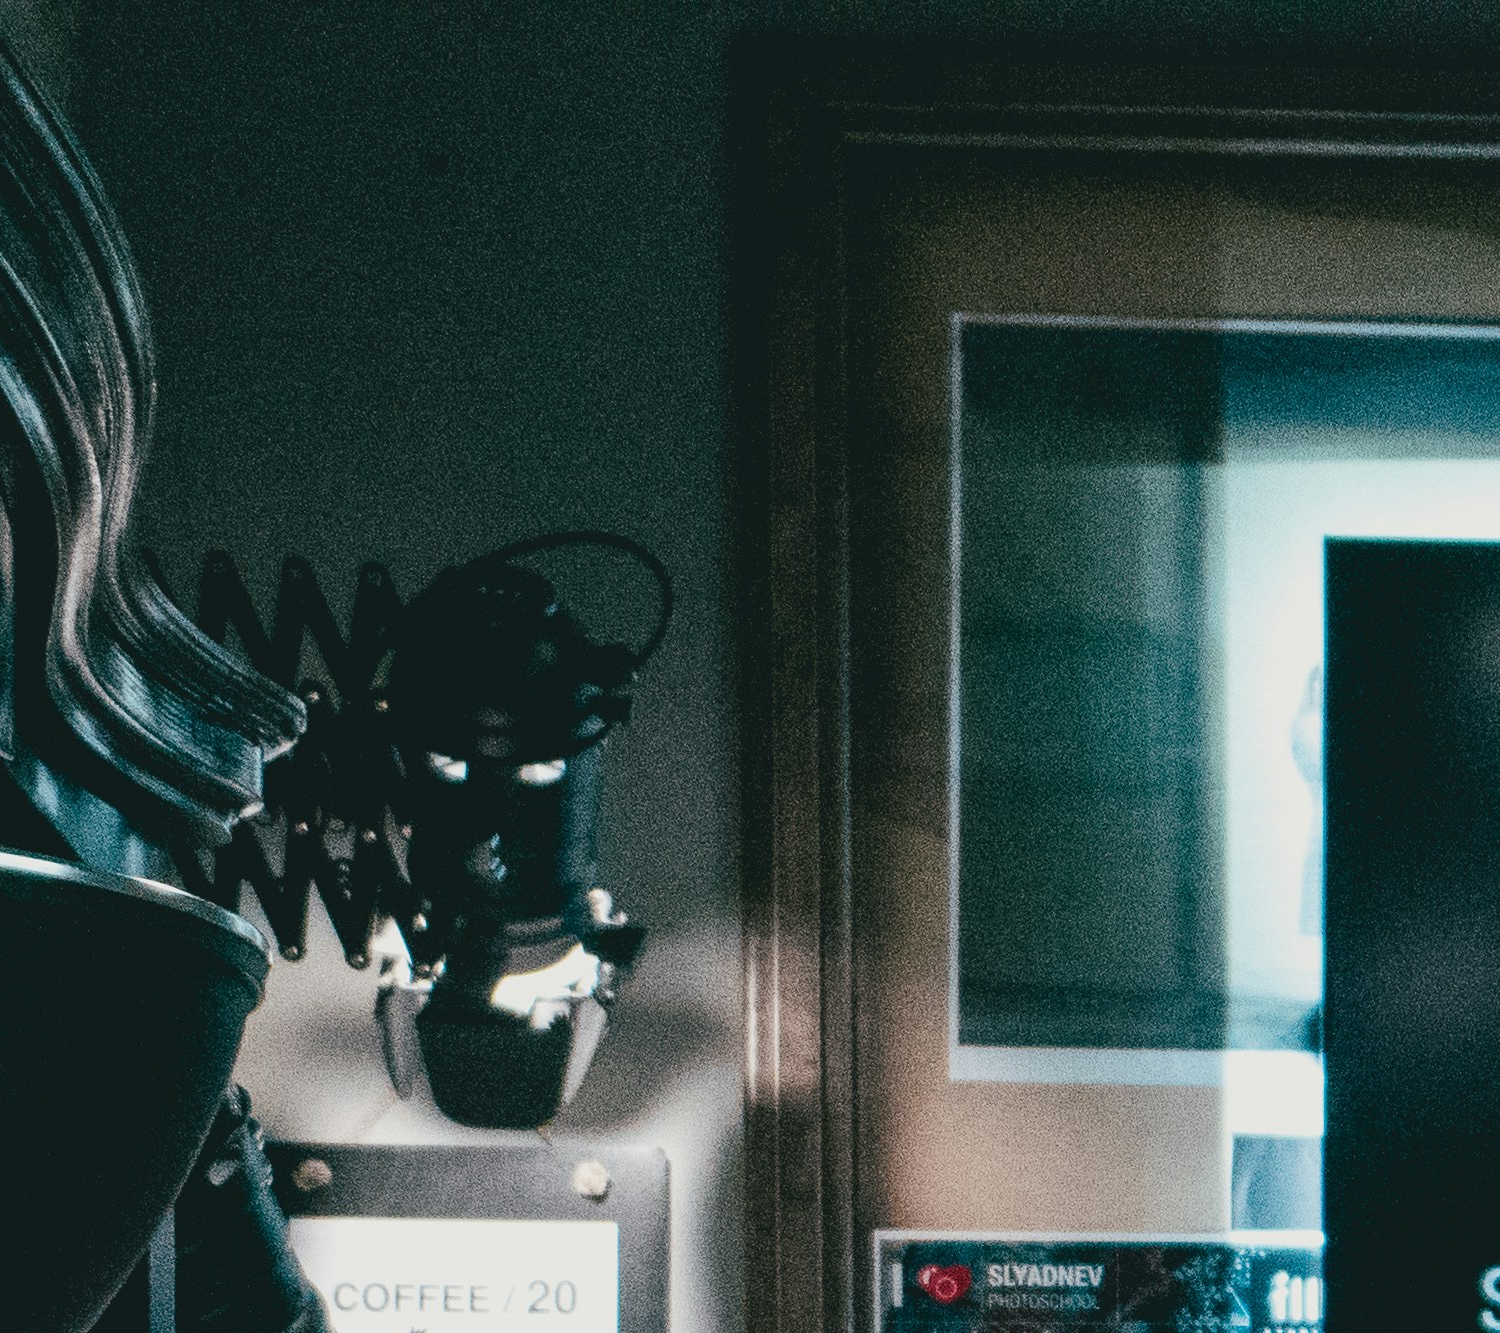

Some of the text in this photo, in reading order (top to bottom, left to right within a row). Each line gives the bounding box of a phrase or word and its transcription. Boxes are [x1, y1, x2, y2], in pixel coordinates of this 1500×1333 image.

[987, 1263, 1105, 1288] SLYADNEV
[333, 1281, 490, 1314] COFFEE
[527, 1280, 578, 1315] 20
[988, 1293, 1101, 1310] PHOTOSCHOOL
